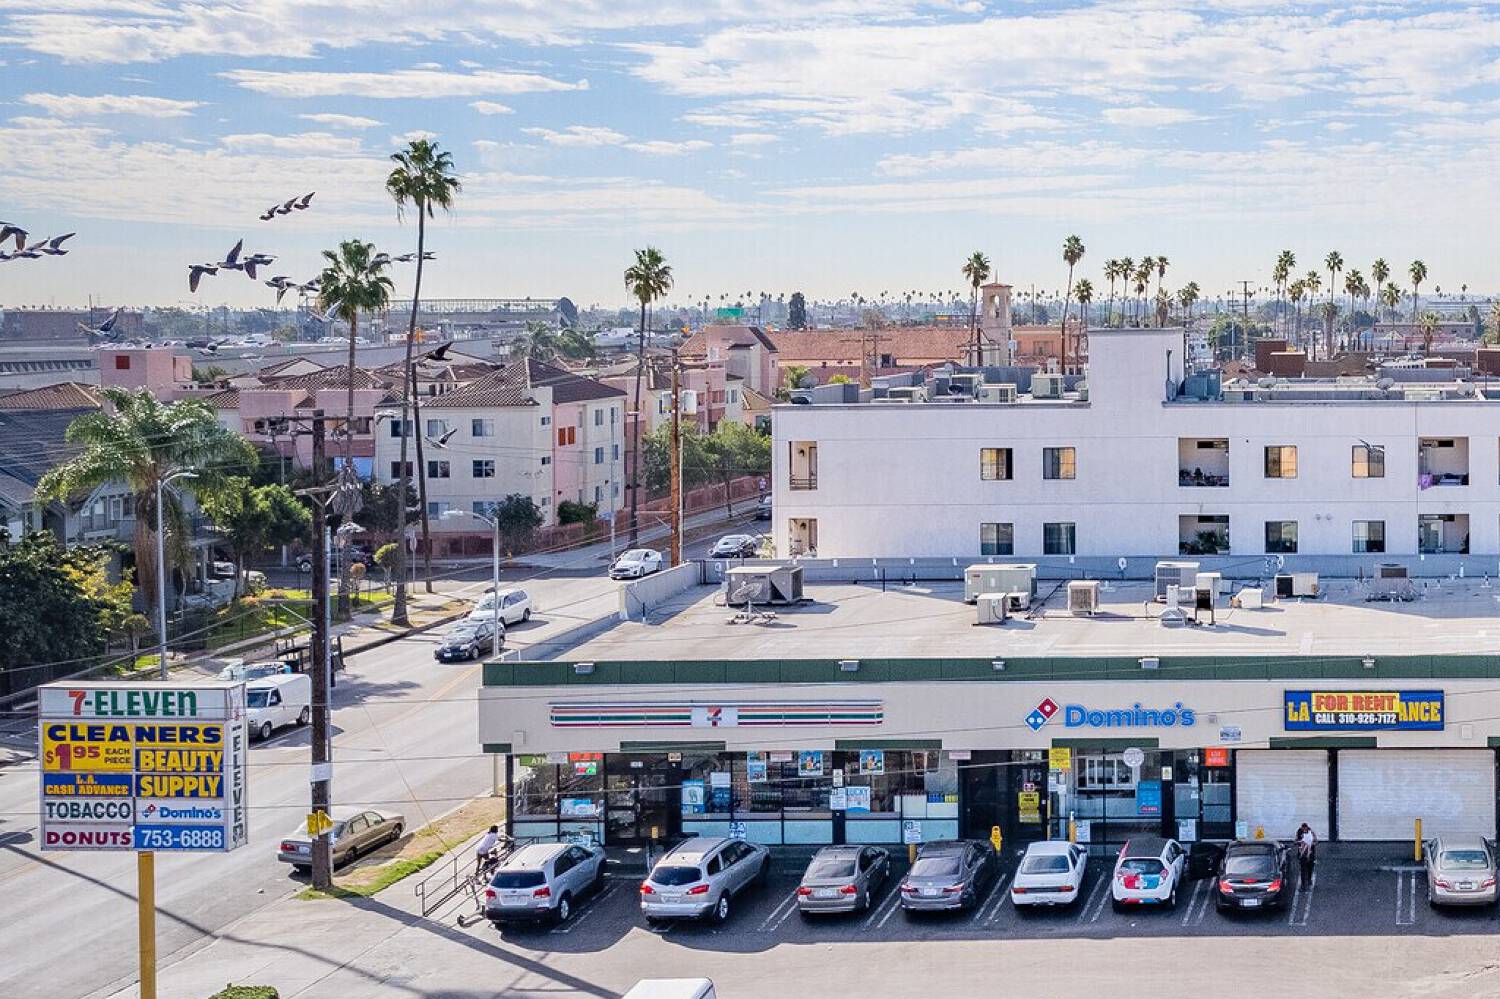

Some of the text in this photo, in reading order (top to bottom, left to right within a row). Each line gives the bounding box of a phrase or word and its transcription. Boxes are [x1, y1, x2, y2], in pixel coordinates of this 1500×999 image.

[1315, 695, 1397, 711] FOR RENT
[1065, 702, 1196, 728] Domino's
[1288, 702, 1311, 722] LA
[1315, 713, 1336, 724] CALL
[48, 725, 221, 743] CLEANERS
[104, 756, 131, 764] PIECE
[141, 751, 223, 771] BEAUTY
[76, 775, 98, 785] L.A.
[140, 775, 220, 798] SUPPLY
[46, 785, 129, 795] CASH ADVANCE
[46, 802, 131, 819] TOBACCO
[160, 806, 222, 820] Domino's
[47, 831, 131, 845] DONUTS
[142, 829, 222, 847] 753-6888
